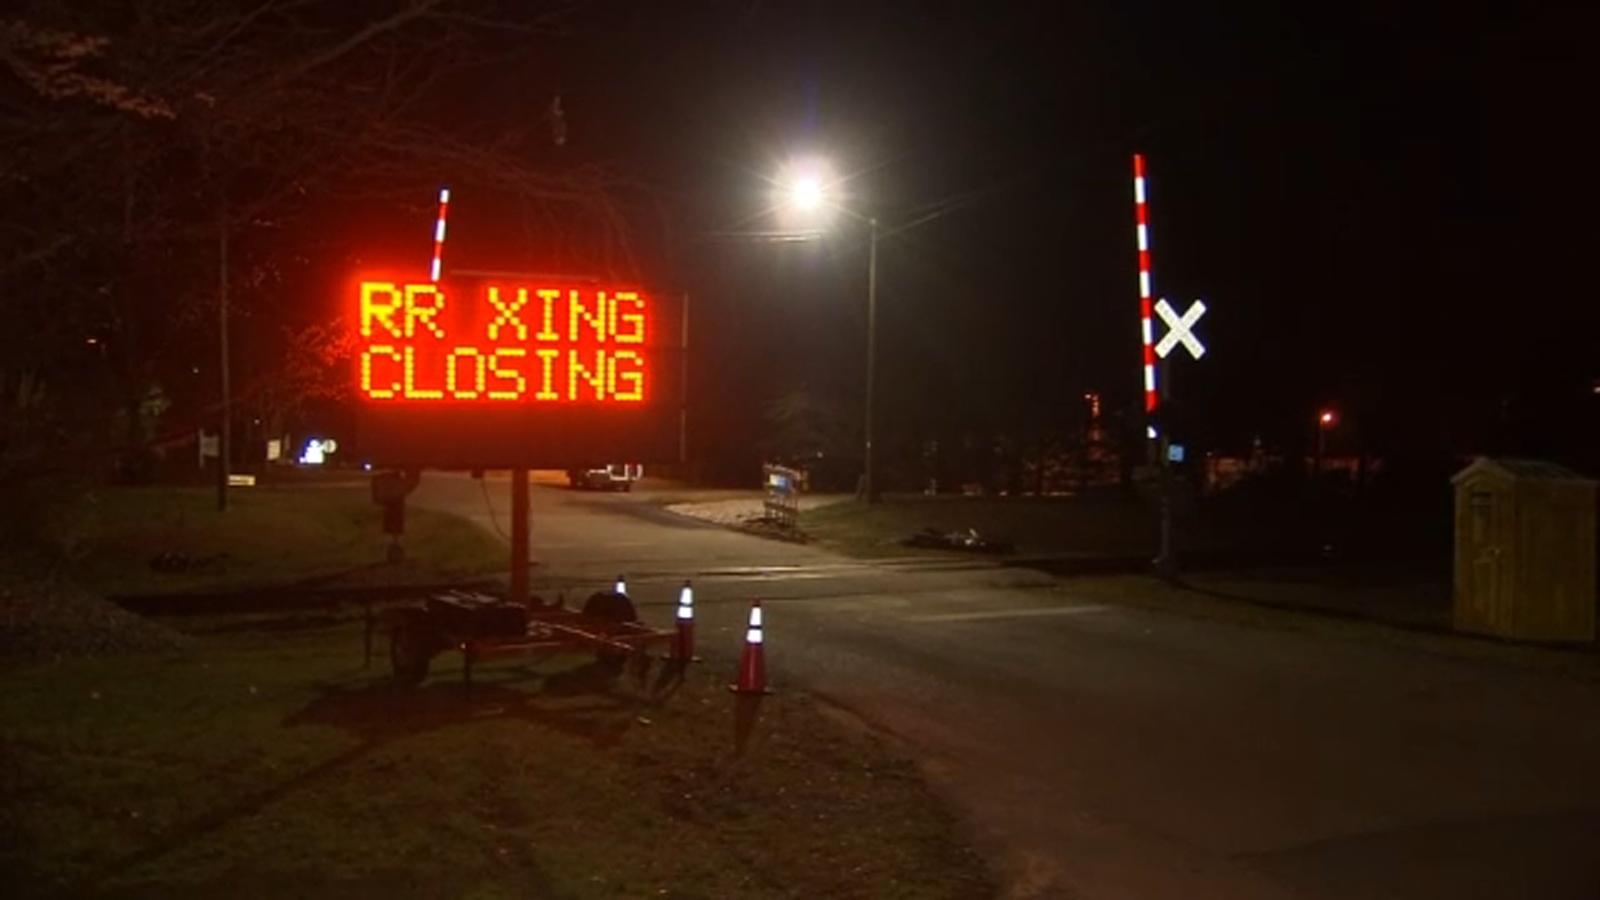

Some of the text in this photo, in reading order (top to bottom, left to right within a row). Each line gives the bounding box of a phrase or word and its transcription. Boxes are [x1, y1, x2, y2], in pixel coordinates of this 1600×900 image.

[360, 282, 644, 343] RR XING
[360, 345, 643, 401] CLOSING
